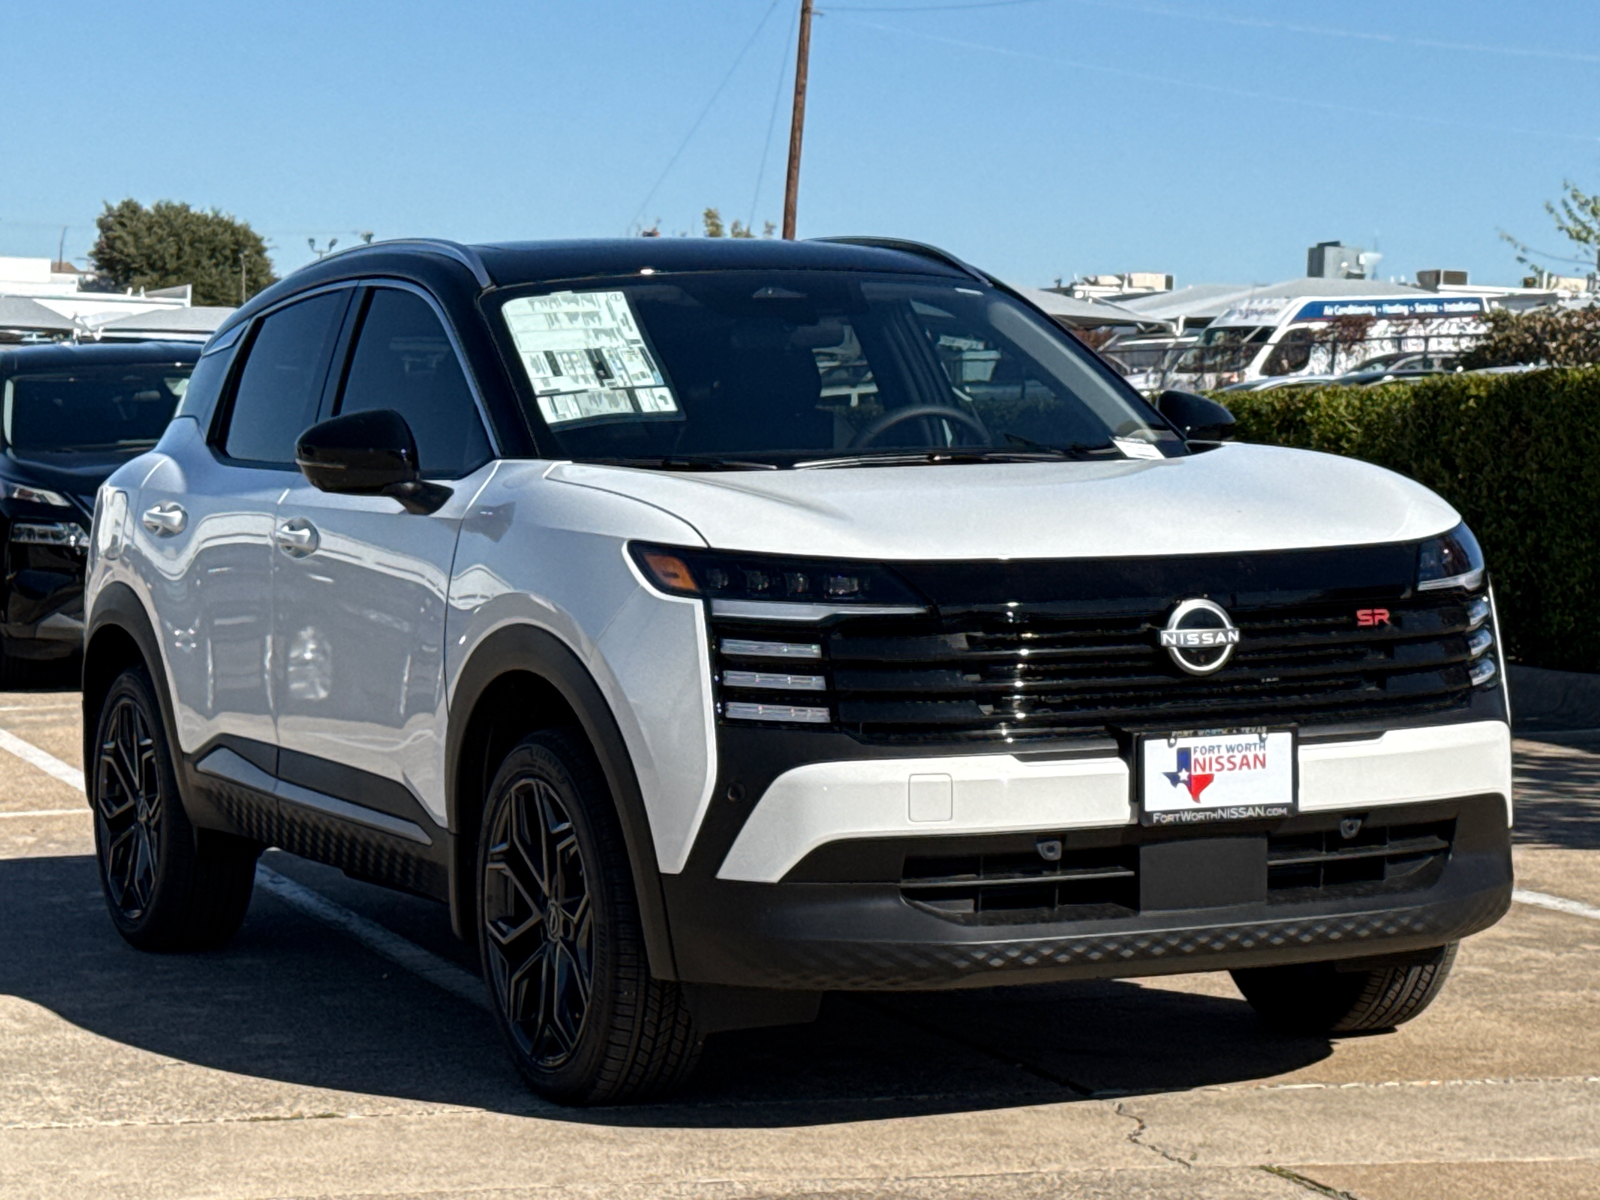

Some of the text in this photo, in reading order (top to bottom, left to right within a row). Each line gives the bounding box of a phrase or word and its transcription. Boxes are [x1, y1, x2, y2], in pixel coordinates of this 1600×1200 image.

[1323, 304, 1334, 316] Air
[1334, 304, 1377, 317] Conditioning
[1382, 303, 1409, 316] Heating
[1414, 302, 1438, 313] Service
[1443, 300, 1480, 312] Installation
[1356, 608, 1390, 627] SR
[1162, 630, 1240, 645] NISSAN
[1193, 742, 1266, 755] FORT WORTH
[1193, 753, 1266, 773] NISSAN
